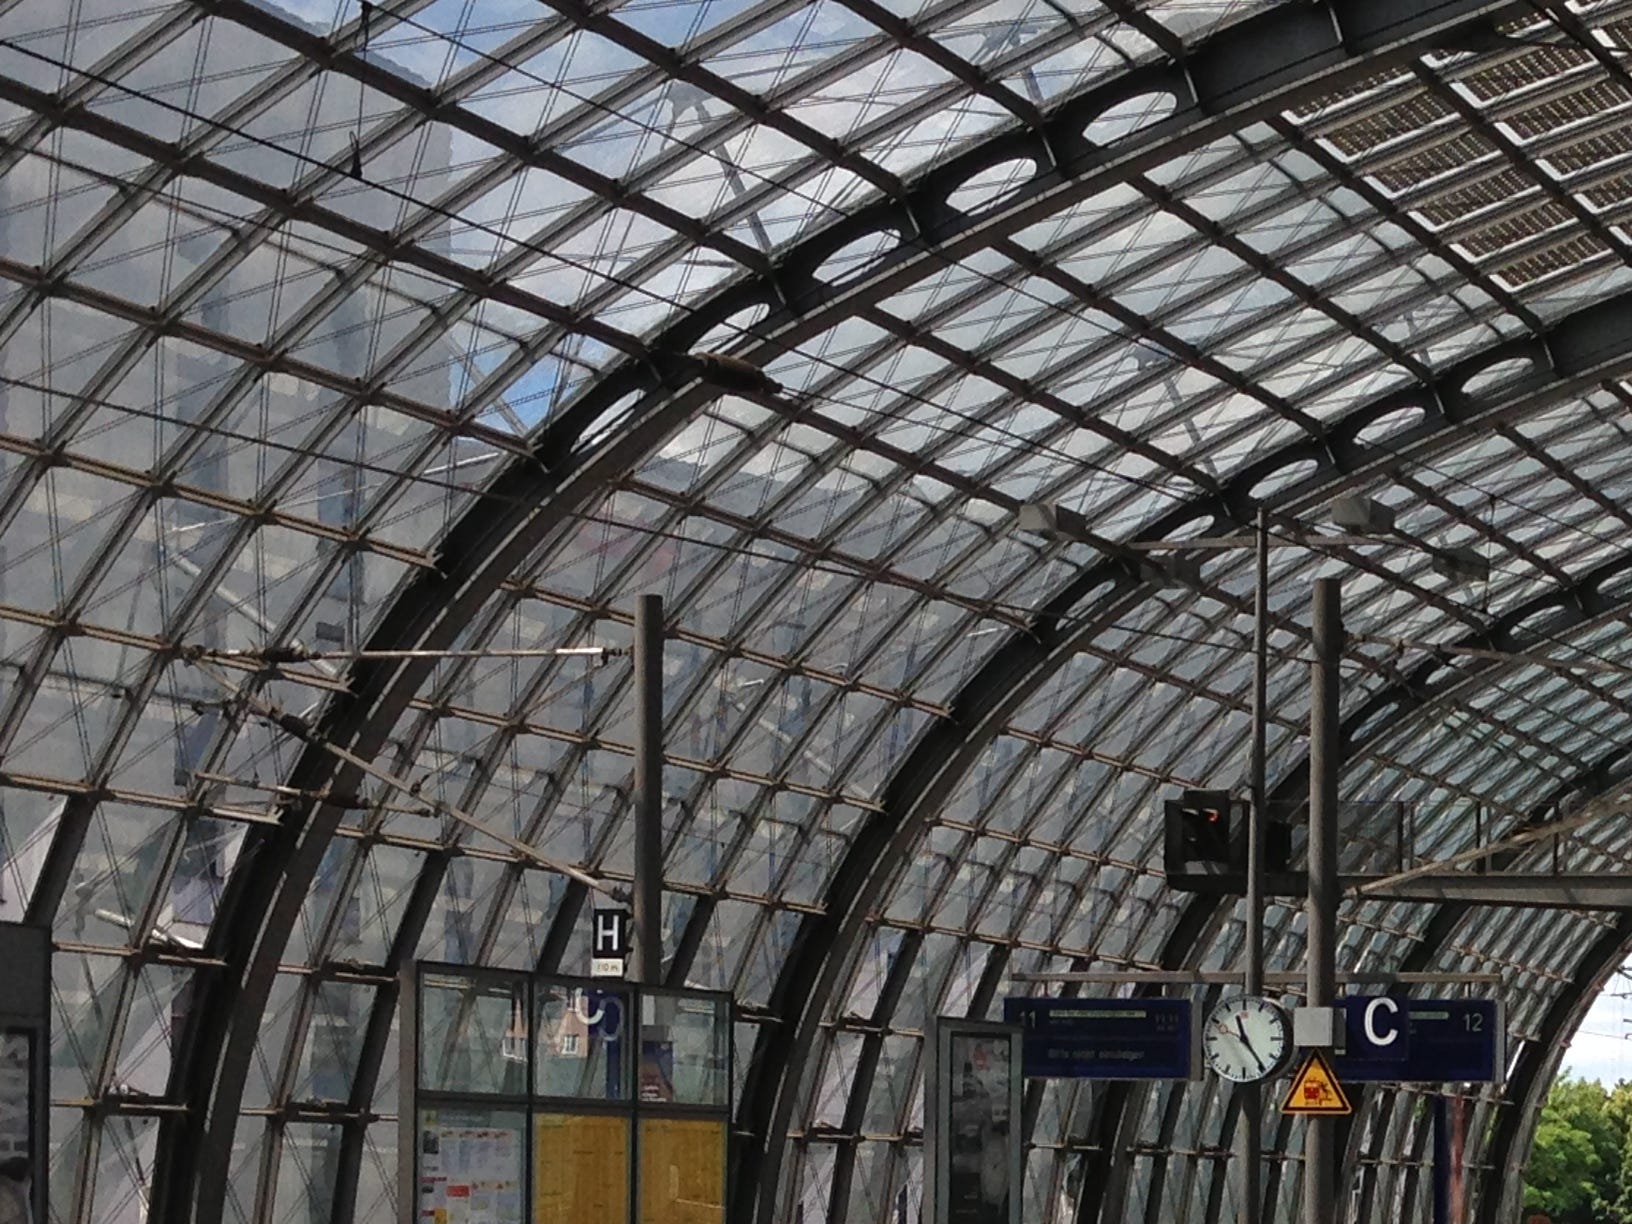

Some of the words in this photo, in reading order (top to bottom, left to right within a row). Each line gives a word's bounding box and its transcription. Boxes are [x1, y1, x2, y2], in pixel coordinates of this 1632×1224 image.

[597, 914, 619, 951] H
[1364, 996, 1399, 1046] C
[1463, 1012, 1484, 1032] 12
